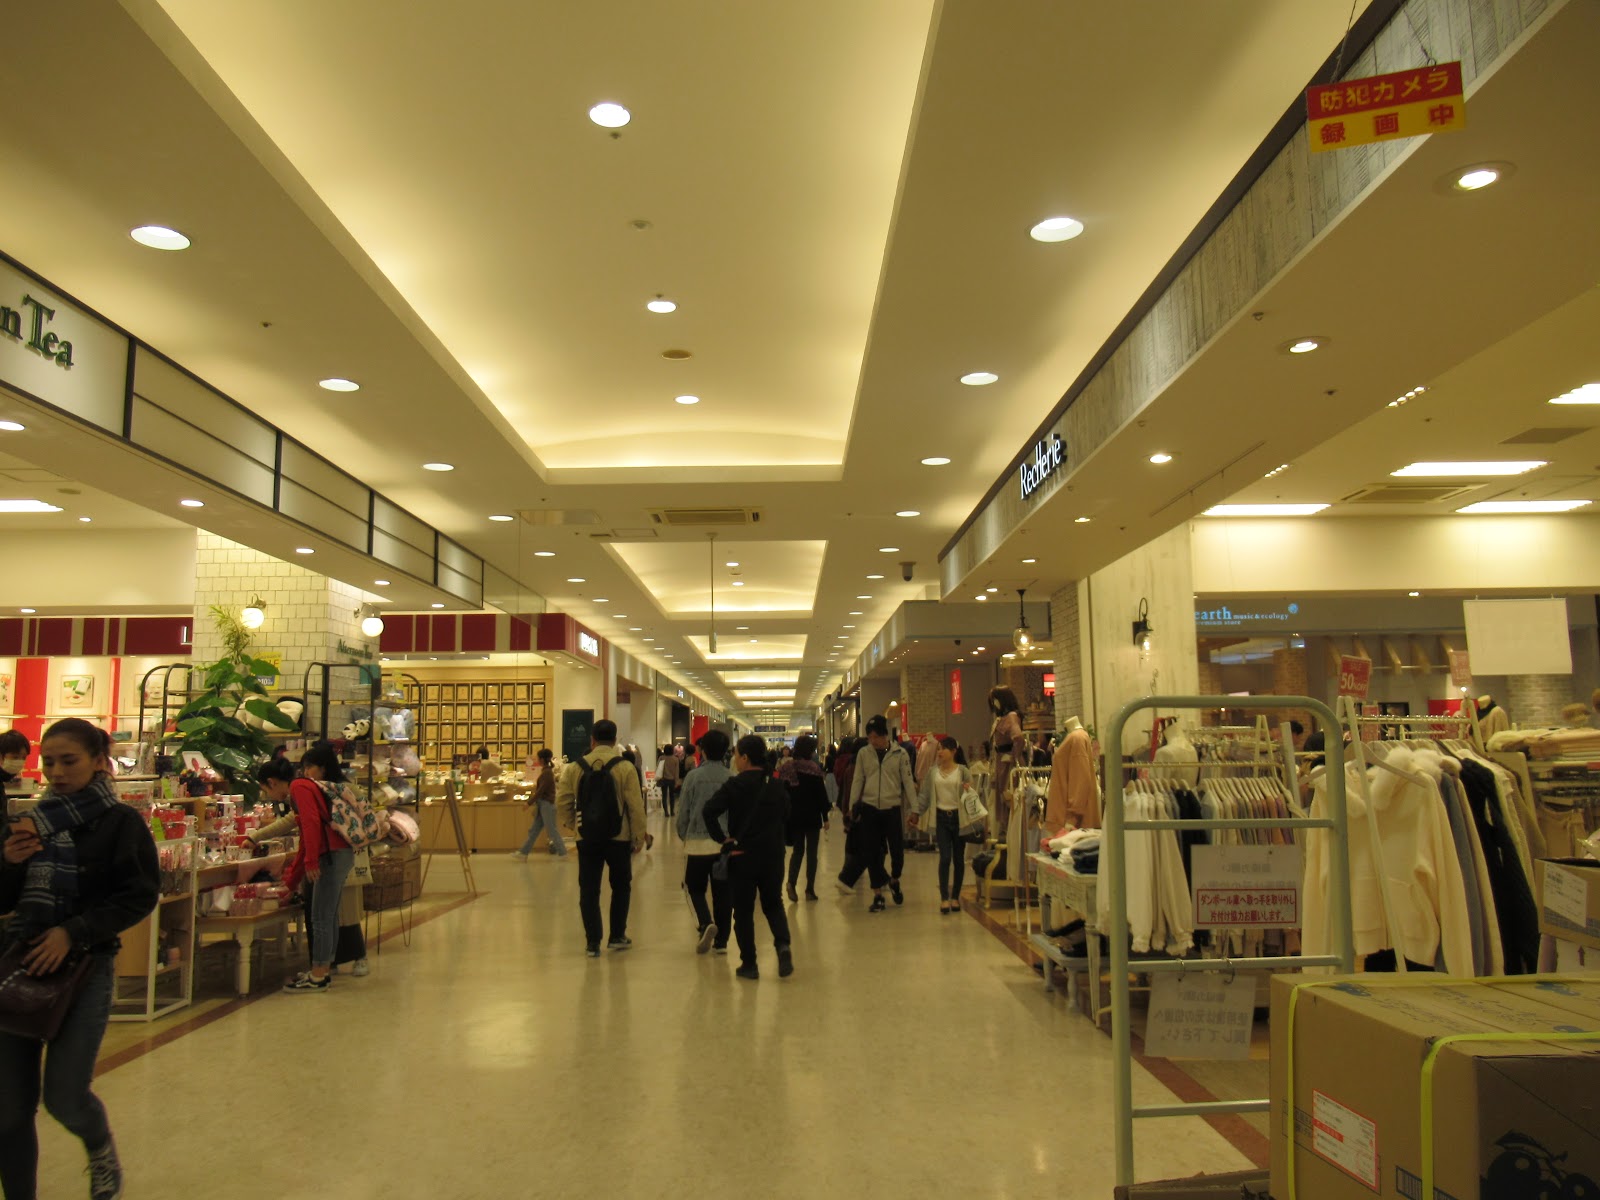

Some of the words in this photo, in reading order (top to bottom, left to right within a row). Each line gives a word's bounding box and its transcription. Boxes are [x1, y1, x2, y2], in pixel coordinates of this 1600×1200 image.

[1320, 70, 1449, 113] 防犯カメラ
